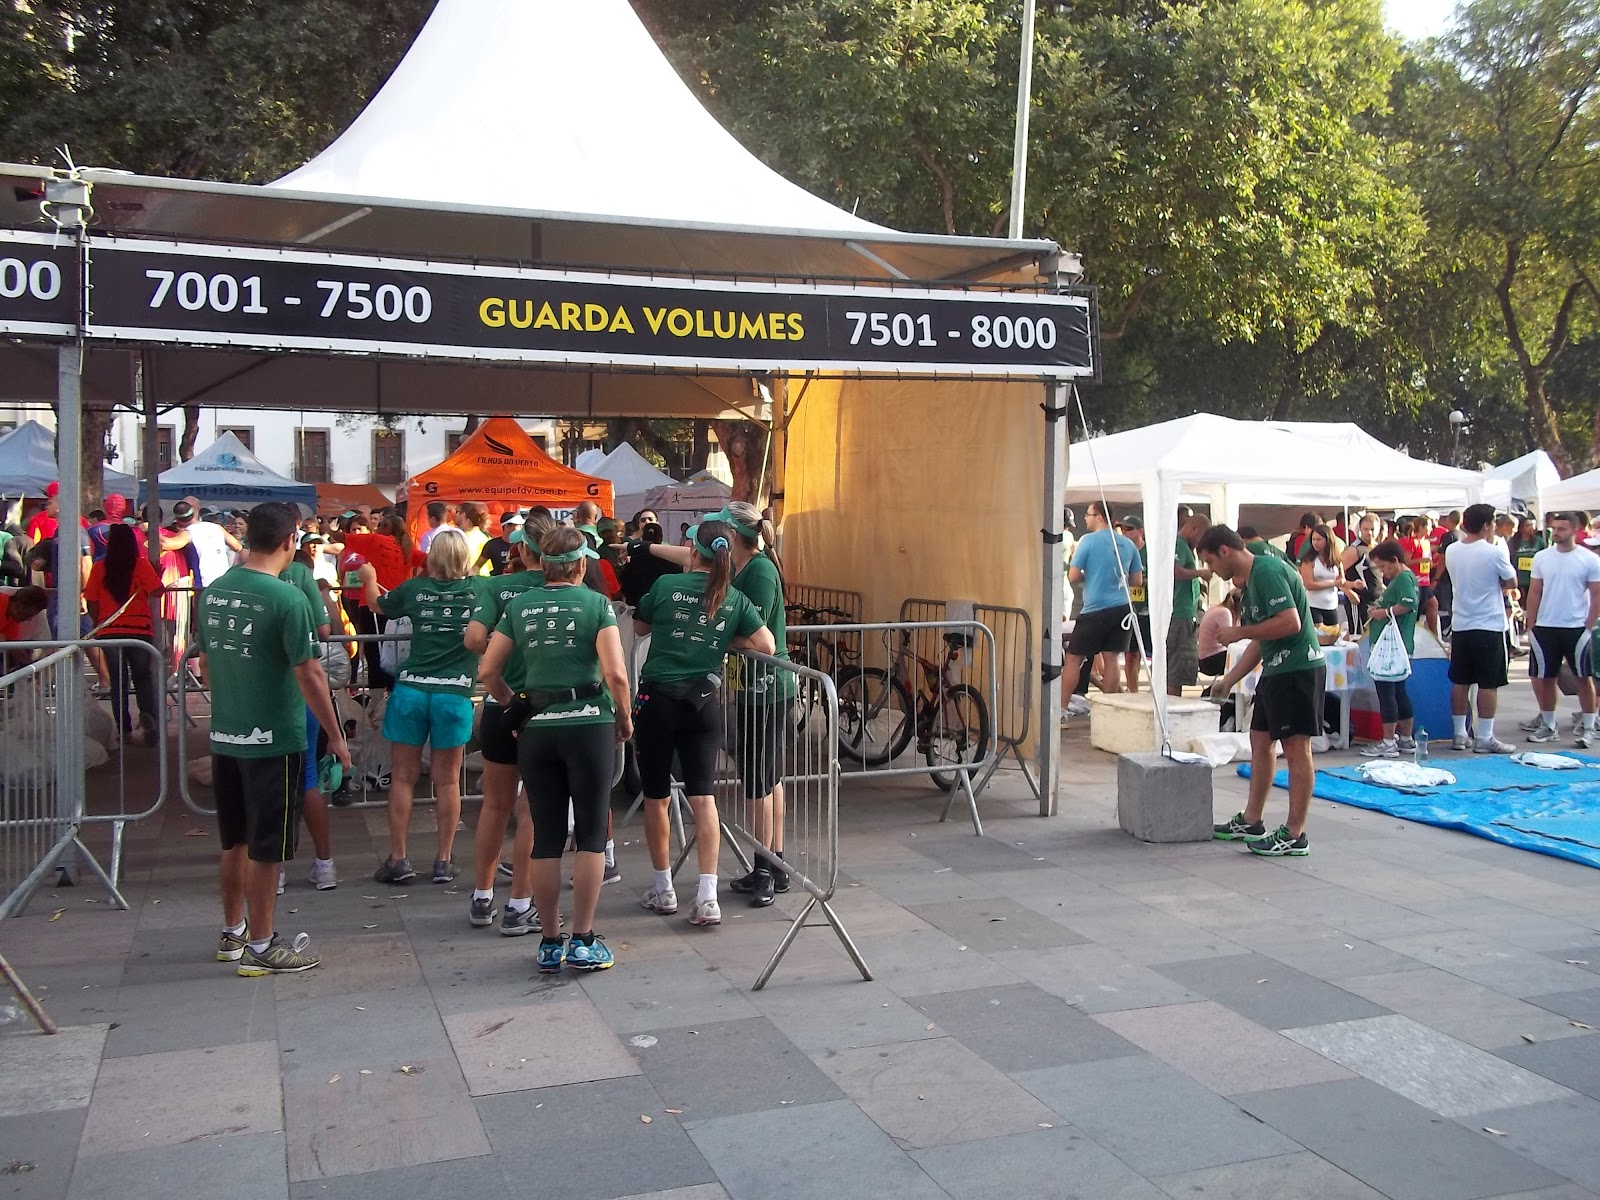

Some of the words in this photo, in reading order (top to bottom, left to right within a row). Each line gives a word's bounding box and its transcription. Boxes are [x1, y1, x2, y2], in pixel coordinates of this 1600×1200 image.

[145, 269, 269, 314] 7001
[316, 280, 433, 323] 7500
[478, 297, 636, 334] GUARDA
[642, 307, 805, 342] VOLUMES
[845, 311, 938, 347] 7501
[971, 315, 1057, 350] 8000
[477, 456, 503, 465] FILHOS
[458, 485, 569, 496] www.equipefdv.com.br
